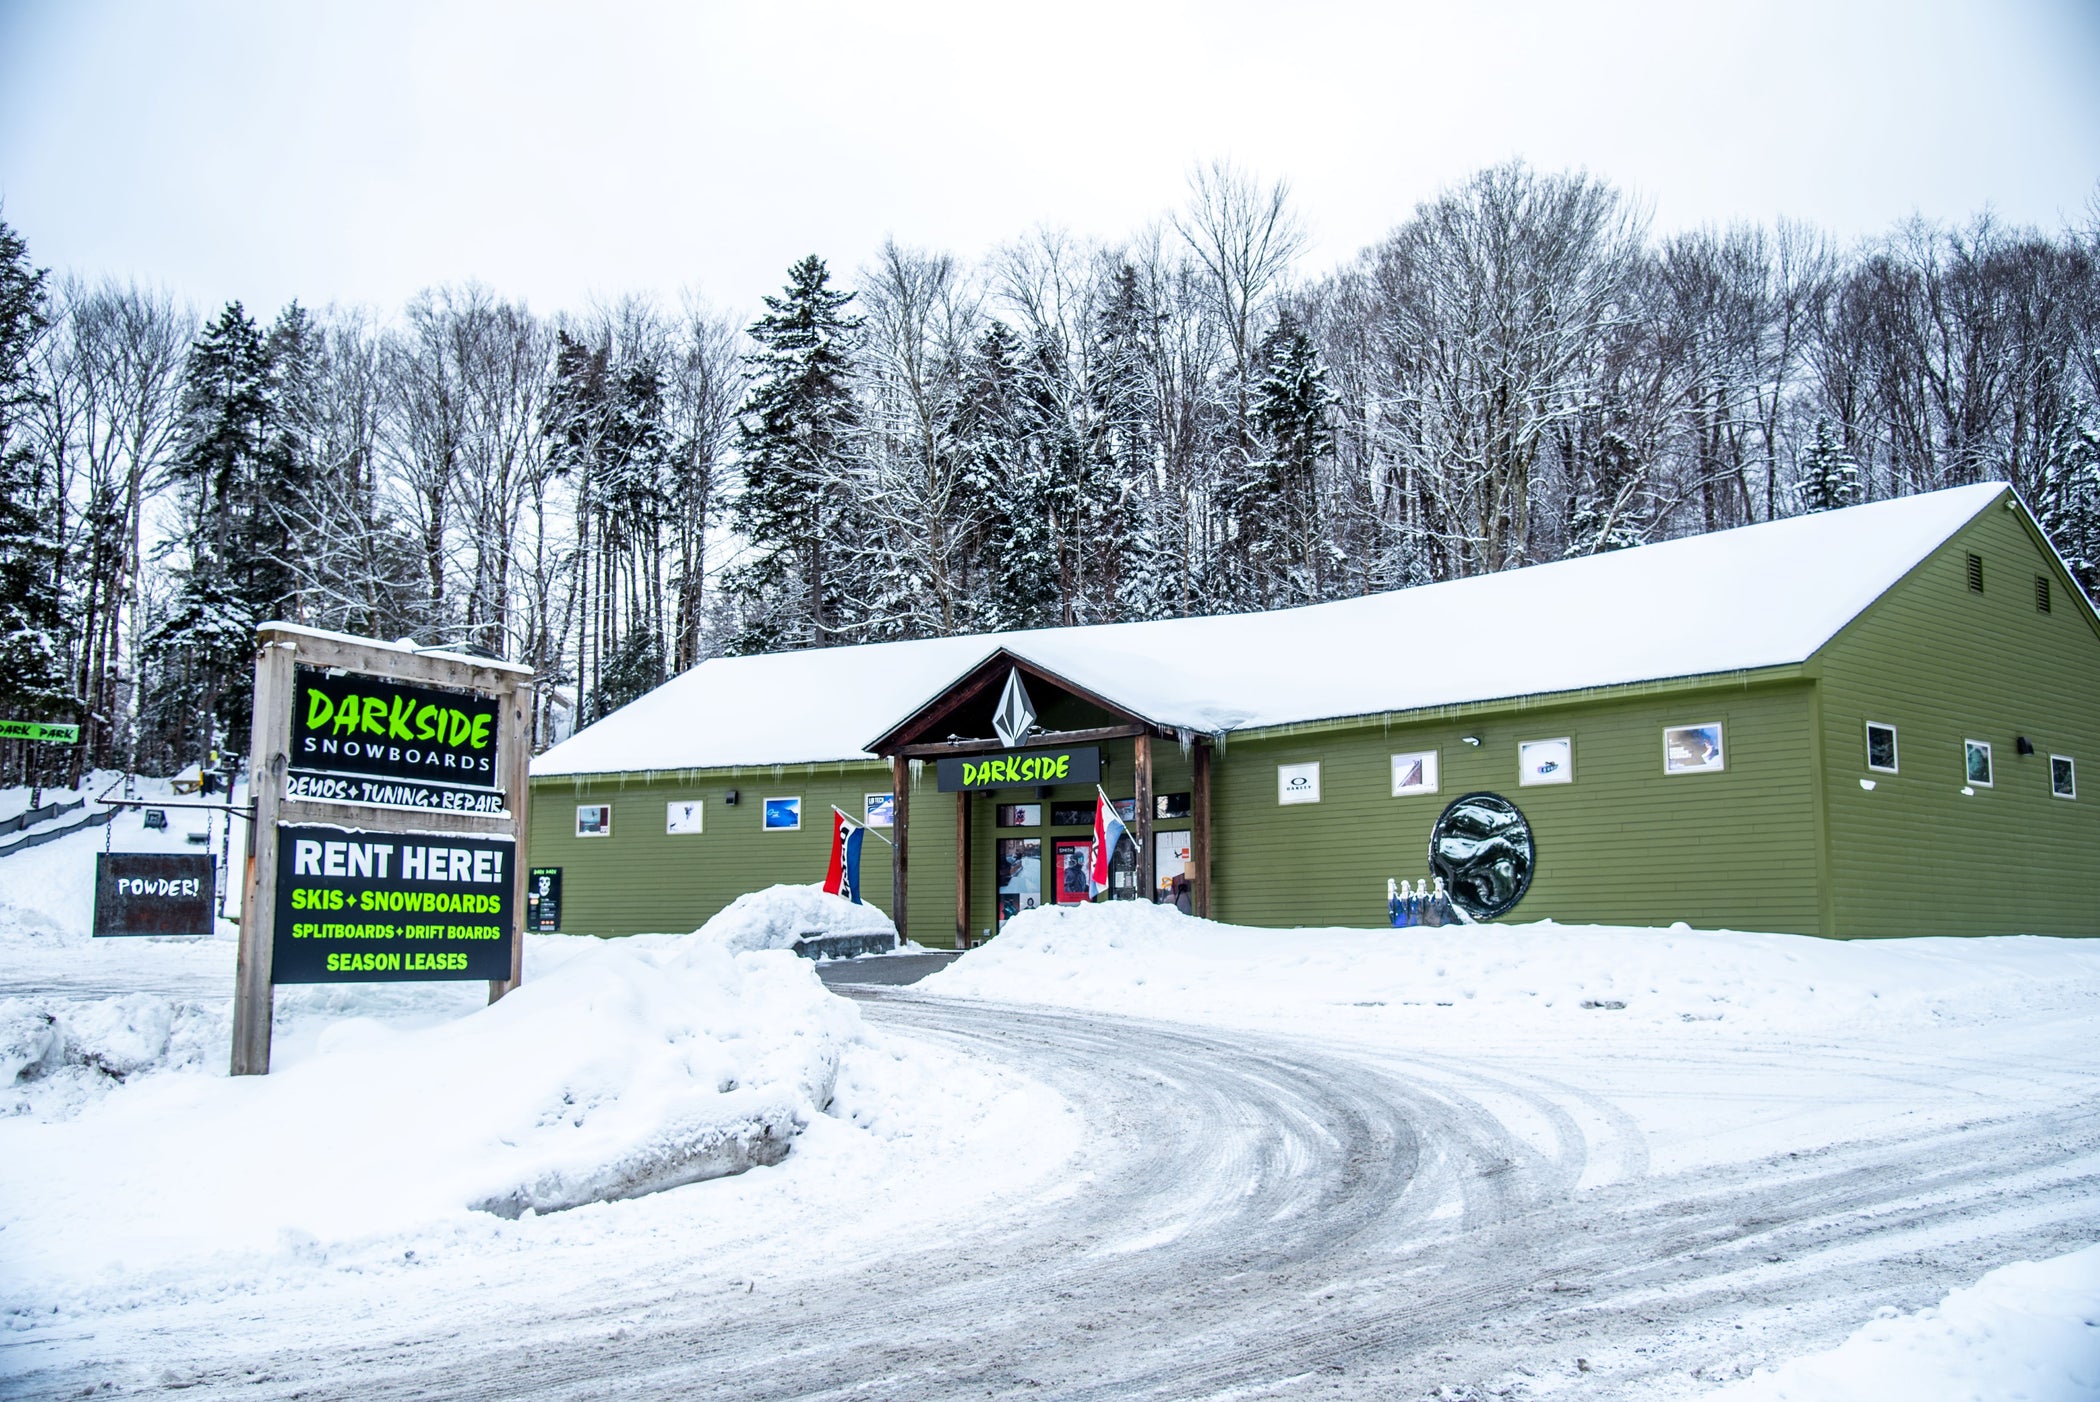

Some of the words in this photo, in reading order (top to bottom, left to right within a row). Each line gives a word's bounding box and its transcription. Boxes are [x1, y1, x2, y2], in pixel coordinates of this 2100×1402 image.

[306, 688, 492, 749] DARKSIDE
[39, 727, 74, 739] PARK
[304, 737, 491, 772] SNOWBOARDS
[962, 755, 1070, 786] DARKSIDE
[286, 776, 348, 800] DEMOS
[362, 783, 429, 808] TUNING
[442, 791, 504, 813] REPAIR
[294, 839, 394, 879] RENT
[402, 846, 503, 883] HERE!
[118, 878, 200, 897] POWDER!
[291, 888, 344, 911] SKIS
[360, 890, 501, 914] SNOWBOARDS
[292, 923, 395, 939] SPLITBOARDS
[405, 925, 445, 939] DRIFT
[447, 925, 501, 940] BOARDS
[326, 953, 400, 971] SEASON
[405, 953, 468, 970] LEASES
